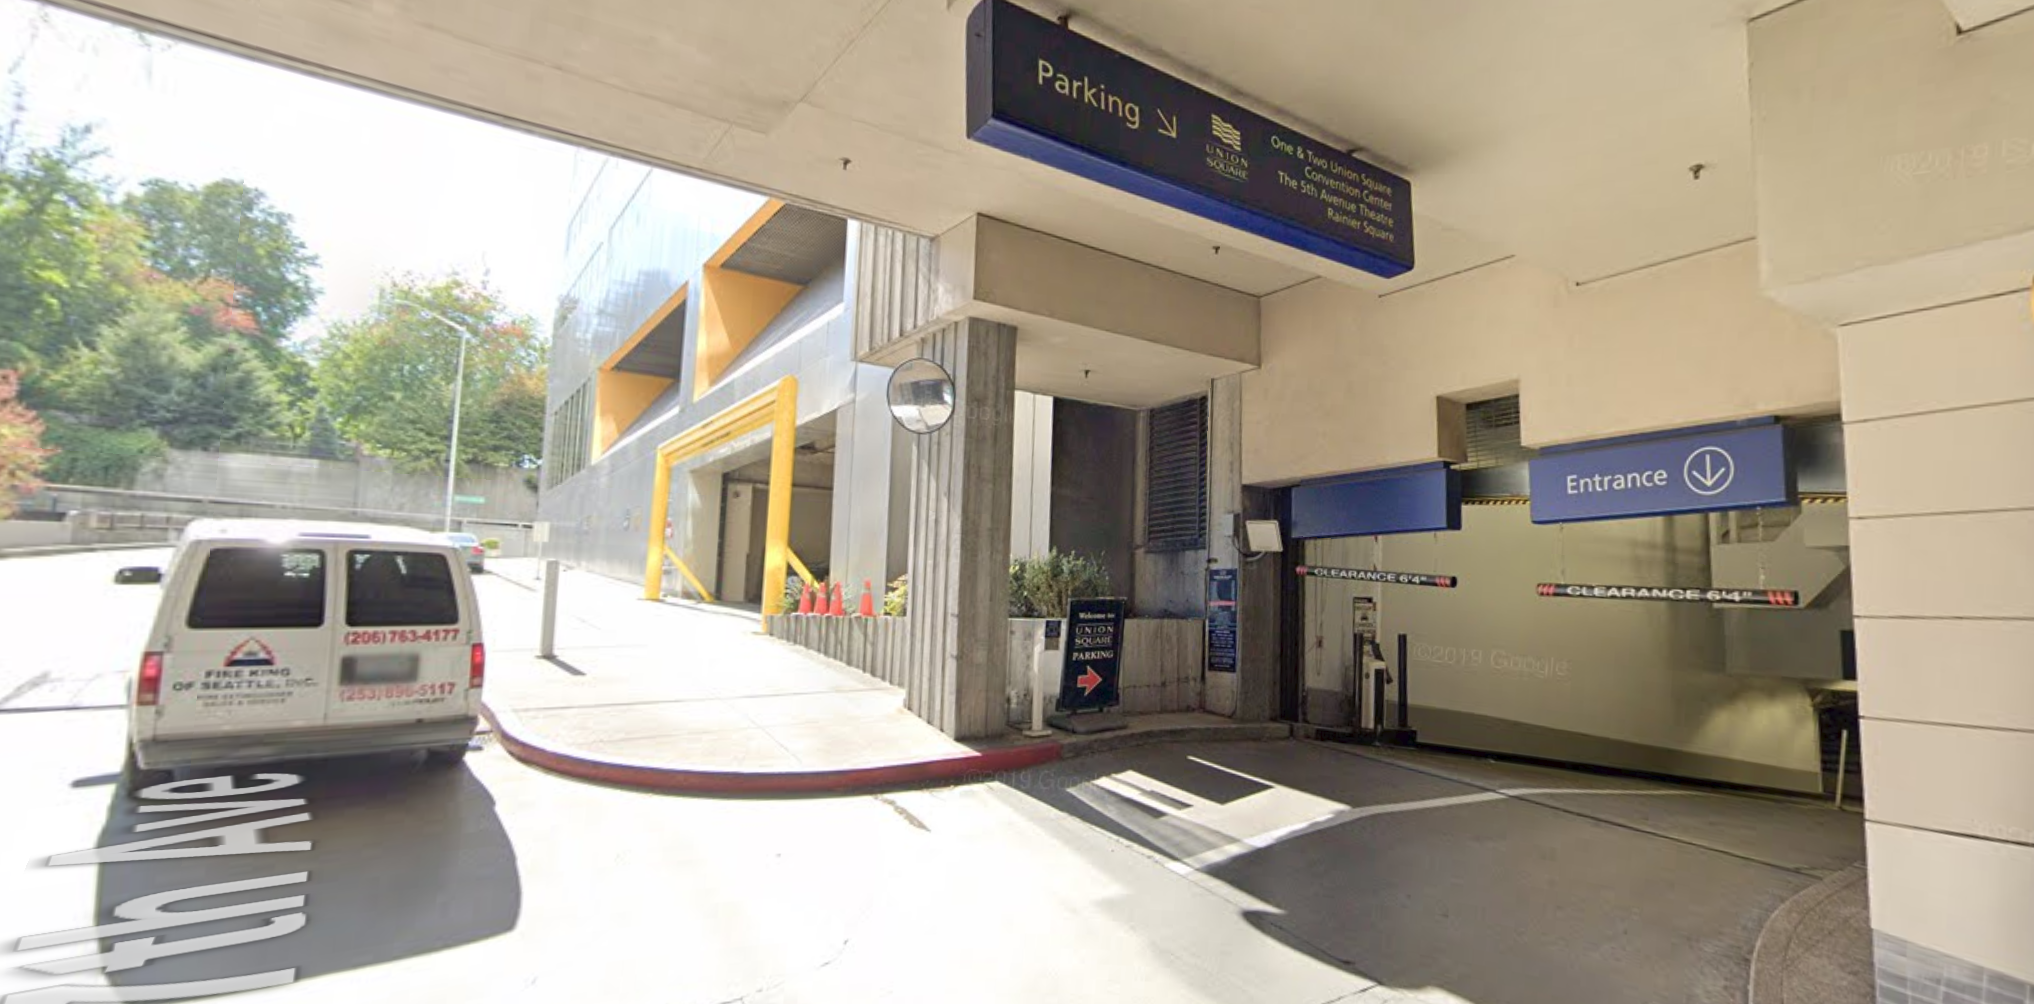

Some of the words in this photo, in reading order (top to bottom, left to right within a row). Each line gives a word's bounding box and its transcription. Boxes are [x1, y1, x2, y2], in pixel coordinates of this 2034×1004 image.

[1038, 58, 1140, 129] Parking
[1205, 143, 1248, 168] UNION
[1206, 157, 1249, 179] SQUARE
[1271, 136, 1293, 155] One
[1297, 146, 1304, 159] &
[1307, 150, 1328, 169] Two
[1330, 161, 1359, 182] Union
[1361, 173, 1392, 196] Square
[1278, 170, 1298, 189] The
[1300, 181, 1318, 198] 5th
[1320, 189, 1357, 212] Avenue
[1359, 203, 1394, 227] Theatre
[1304, 166, 1361, 198] Convention
[1363, 190, 1392, 211] Center
[1328, 208, 1361, 229] Rainier
[1363, 221, 1394, 242] Square
[1567, 469, 1668, 494] Entrance
[1314, 567, 1396, 582] CLEARANCE
[1399, 575, 1427, 584] 6'4"
[1566, 585, 1700, 600] CLEARANCE
[1706, 589, 1752, 603] 6'4"
[344, 630, 386, 645] (206)
[388, 628, 459, 643] 763-4177
[1076, 626, 1113, 634] UNION
[1075, 636, 1112, 645] SQUARE
[1072, 650, 1114, 660] PARKING
[204, 669, 245, 679] FIRE
[249, 668, 291, 677] KING
[172, 681, 194, 691] OF
[201, 679, 280, 690] SEATTLE,
